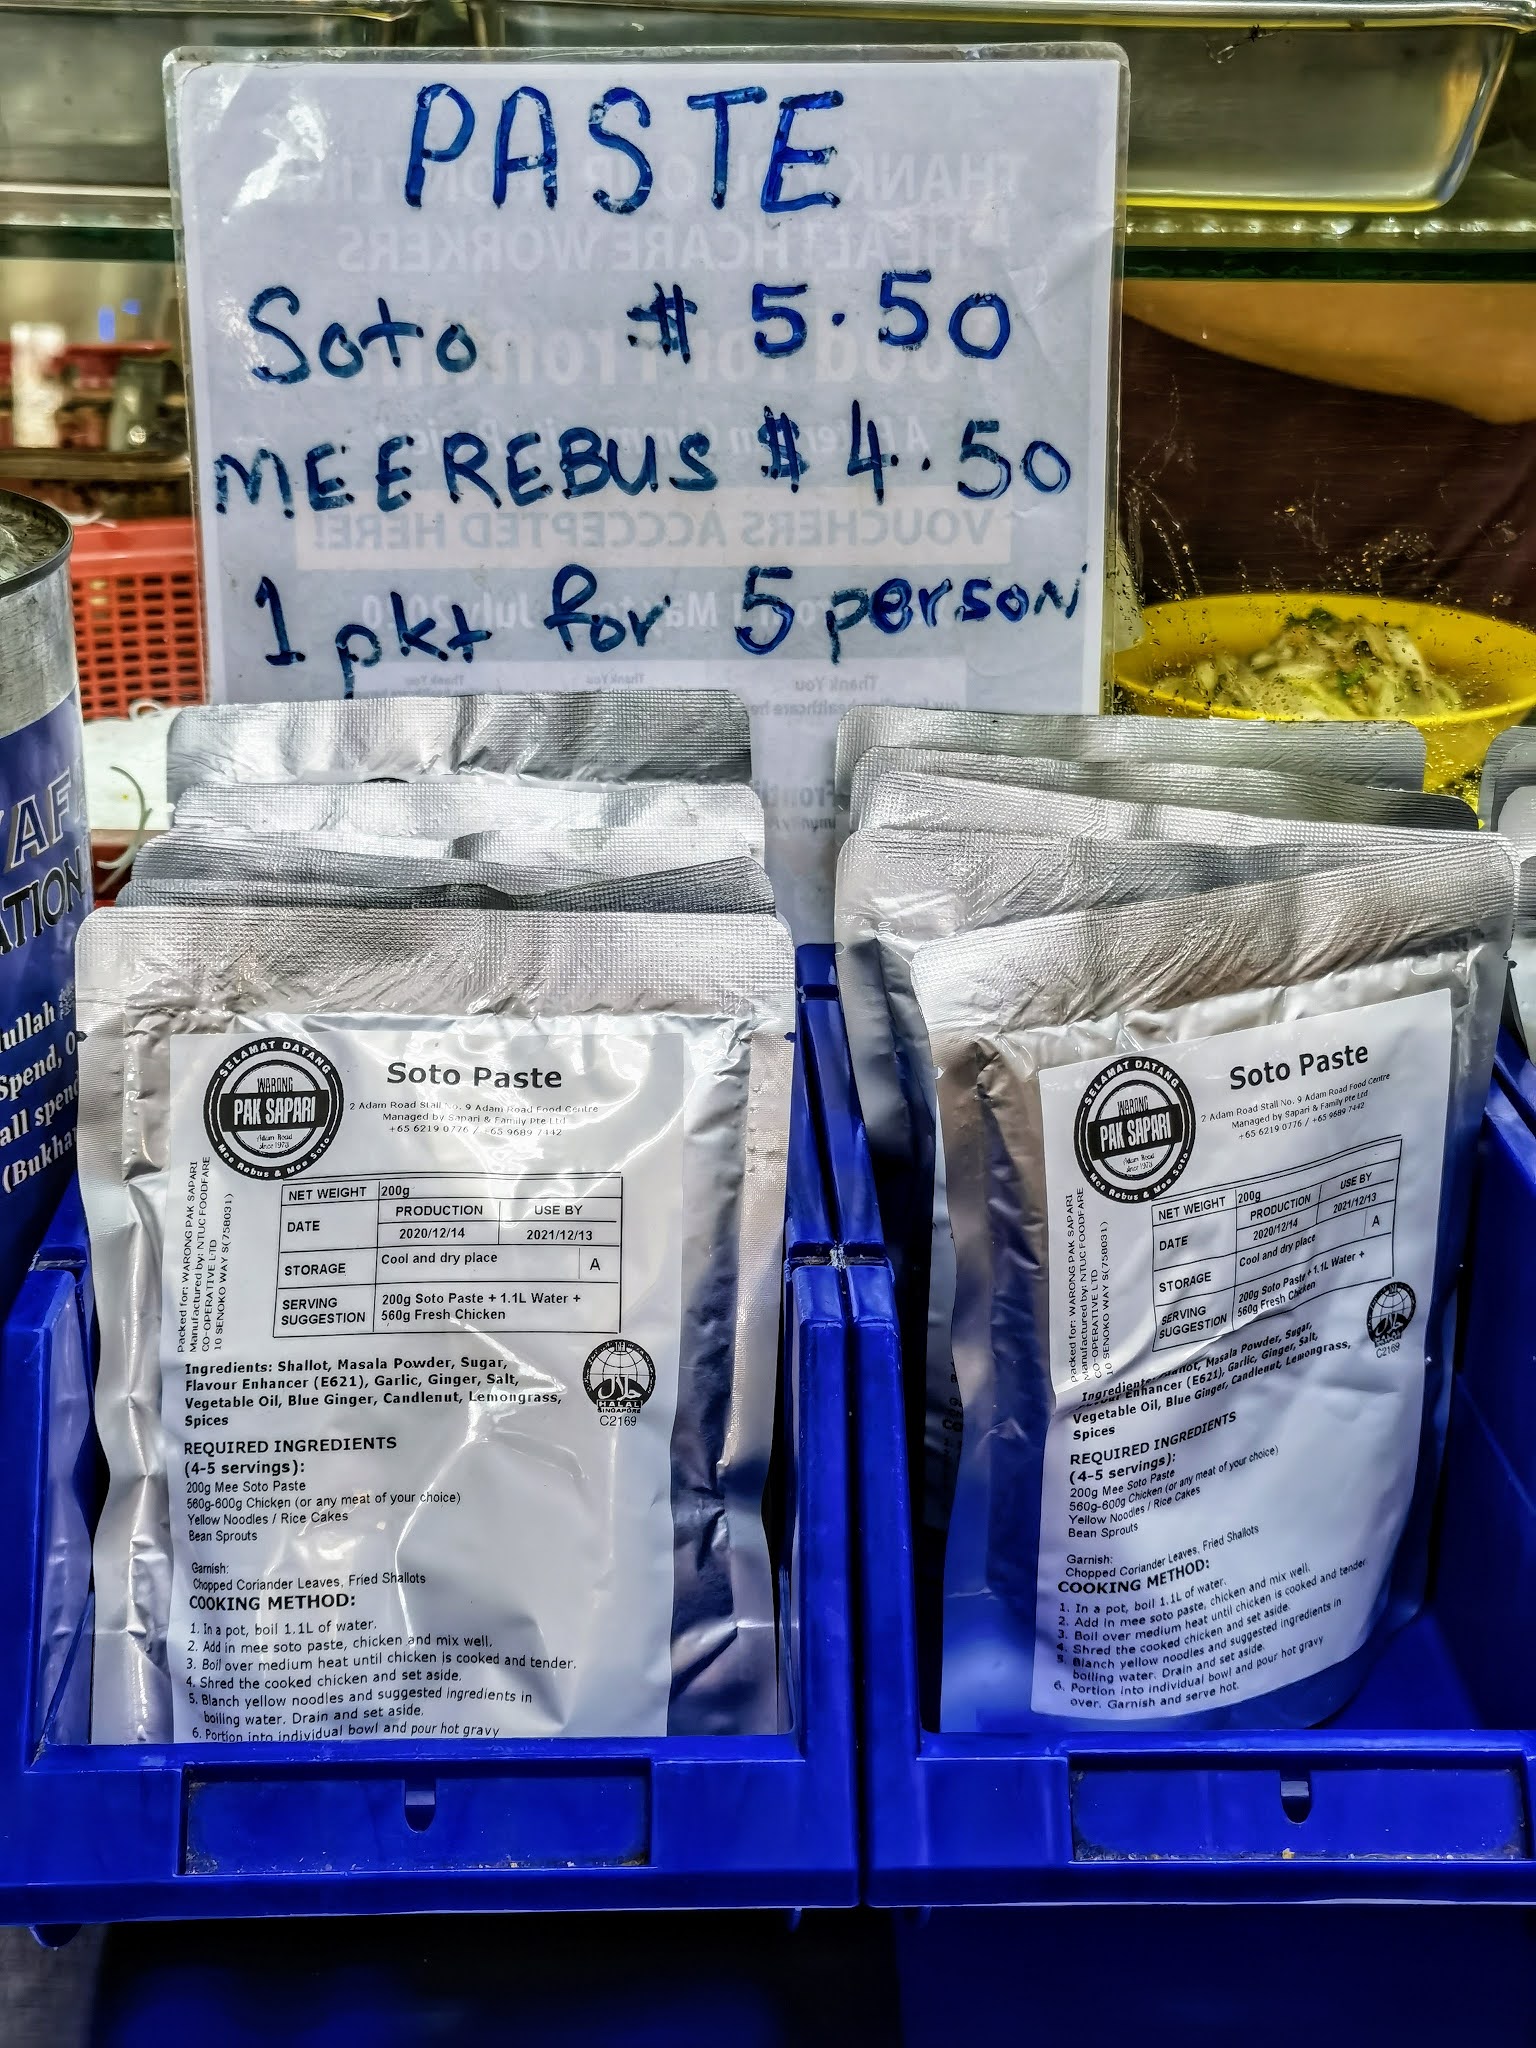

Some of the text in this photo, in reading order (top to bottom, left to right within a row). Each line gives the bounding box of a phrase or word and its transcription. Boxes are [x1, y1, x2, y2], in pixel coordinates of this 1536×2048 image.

[404, 83, 846, 216] PASTE
[247, 285, 479, 384] Soto
[627, 281, 700, 364] $
[751, 269, 1012, 360] 5.50
[757, 405, 810, 493] $
[255, 576, 306, 666] 1
[335, 591, 493, 700] pkt
[543, 564, 672, 652] for
[736, 565, 795, 656] 5
[220, 1041, 331, 1077] SELAMAT DATANG
[1229, 1044, 1368, 1090] Soto Paste
[386, 1061, 562, 1089] Soto Paste
[1084, 1060, 1181, 1106] SELAMAT DATANG
[233, 1096, 316, 1126] PAK SAPARI
[1100, 1111, 1172, 1153] PAK SAPARI
[1339, 1171, 1372, 1190] USE BY
[288, 1186, 367, 1201] NET WEIGHT
[381, 1184, 410, 1198] 200g
[395, 1204, 483, 1217] PRODUCTION
[534, 1204, 583, 1215] USE BY
[1158, 1195, 1226, 1221] NET WEIGHT
[1250, 1193, 1311, 1221] PRODUCTION
[1332, 1191, 1377, 1214] 2021/12/13
[182, 1161, 198, 1283] WARONG PAK SAPARI
[287, 1220, 320, 1233] DATE
[1252, 1217, 1298, 1241] 2020/12/14
[1371, 1214, 1380, 1227] A
[399, 1227, 465, 1239] 2020/12/14
[526, 1229, 592, 1241] 2021/12/13
[1159, 1234, 1188, 1251] DATE
[381, 1251, 498, 1265] Cool and dry place
[1239, 1233, 1316, 1268] Cool and dry place
[284, 1262, 346, 1276] STORAGE
[589, 1257, 601, 1271] A
[1158, 1271, 1211, 1293] STORAGE
[282, 1297, 337, 1310] SERVING
[382, 1293, 411, 1307] 200g
[415, 1293, 444, 1304] Soto
[448, 1292, 484, 1304] Paste
[500, 1292, 527, 1303] 1.1L
[530, 1292, 569, 1304] Water
[281, 1311, 365, 1326] SUGGESTION
[381, 1308, 506, 1323] 560g Fresh Chicken
[184, 1356, 507, 1377] Ingredients: Shallot, Masala Powder, Sugar,
[185, 1372, 519, 1392] Flavour Enhancer (E621), Garlic, Ginger, Salt,
[184, 1395, 254, 1411] Vegetable
[258, 1394, 282, 1408] Oil,
[288, 1393, 319, 1406] Blue
[323, 1392, 378, 1407] Ginger,
[383, 1390, 463, 1404] Candlenut,
[184, 1413, 228, 1429] Spices
[599, 1415, 637, 1427] C2169
[1070, 1411, 1236, 1465] REQUIRED INGREDIENTS
[1072, 1426, 1115, 1442] Spices
[184, 1436, 397, 1457] REQUIRED INGREDIENTS
[185, 1479, 306, 1496] 200g Mee Soto Paste
[245, 1496, 291, 1509] Chicken
[294, 1496, 312, 1509] (or
[316, 1497, 337, 1509] any
[340, 1493, 370, 1505] meat
[374, 1491, 387, 1503] of
[389, 1493, 416, 1506] your
[419, 1491, 461, 1507] choice)
[187, 1513, 221, 1526] Yellow
[223, 1513, 269, 1525] Noodles
[280, 1512, 307, 1524] Rice
[310, 1510, 349, 1524] Cakes
[188, 1529, 258, 1544] Bean Sprouts
[192, 1577, 233, 1593] Chopped
[236, 1577, 293, 1591] Coriander
[348, 1572, 378, 1586] Fried
[381, 1571, 426, 1584] Shallots
[1057, 1560, 1209, 1594] COOKING METHOD:
[189, 1593, 355, 1611] COOKING METHOD:
[199, 1675, 234, 1689] Shred
[238, 1676, 260, 1690] the
[264, 1674, 312, 1689] cooked
[317, 1672, 368, 1687] chicken
[372, 1669, 396, 1683] and
[401, 1669, 422, 1681] set
